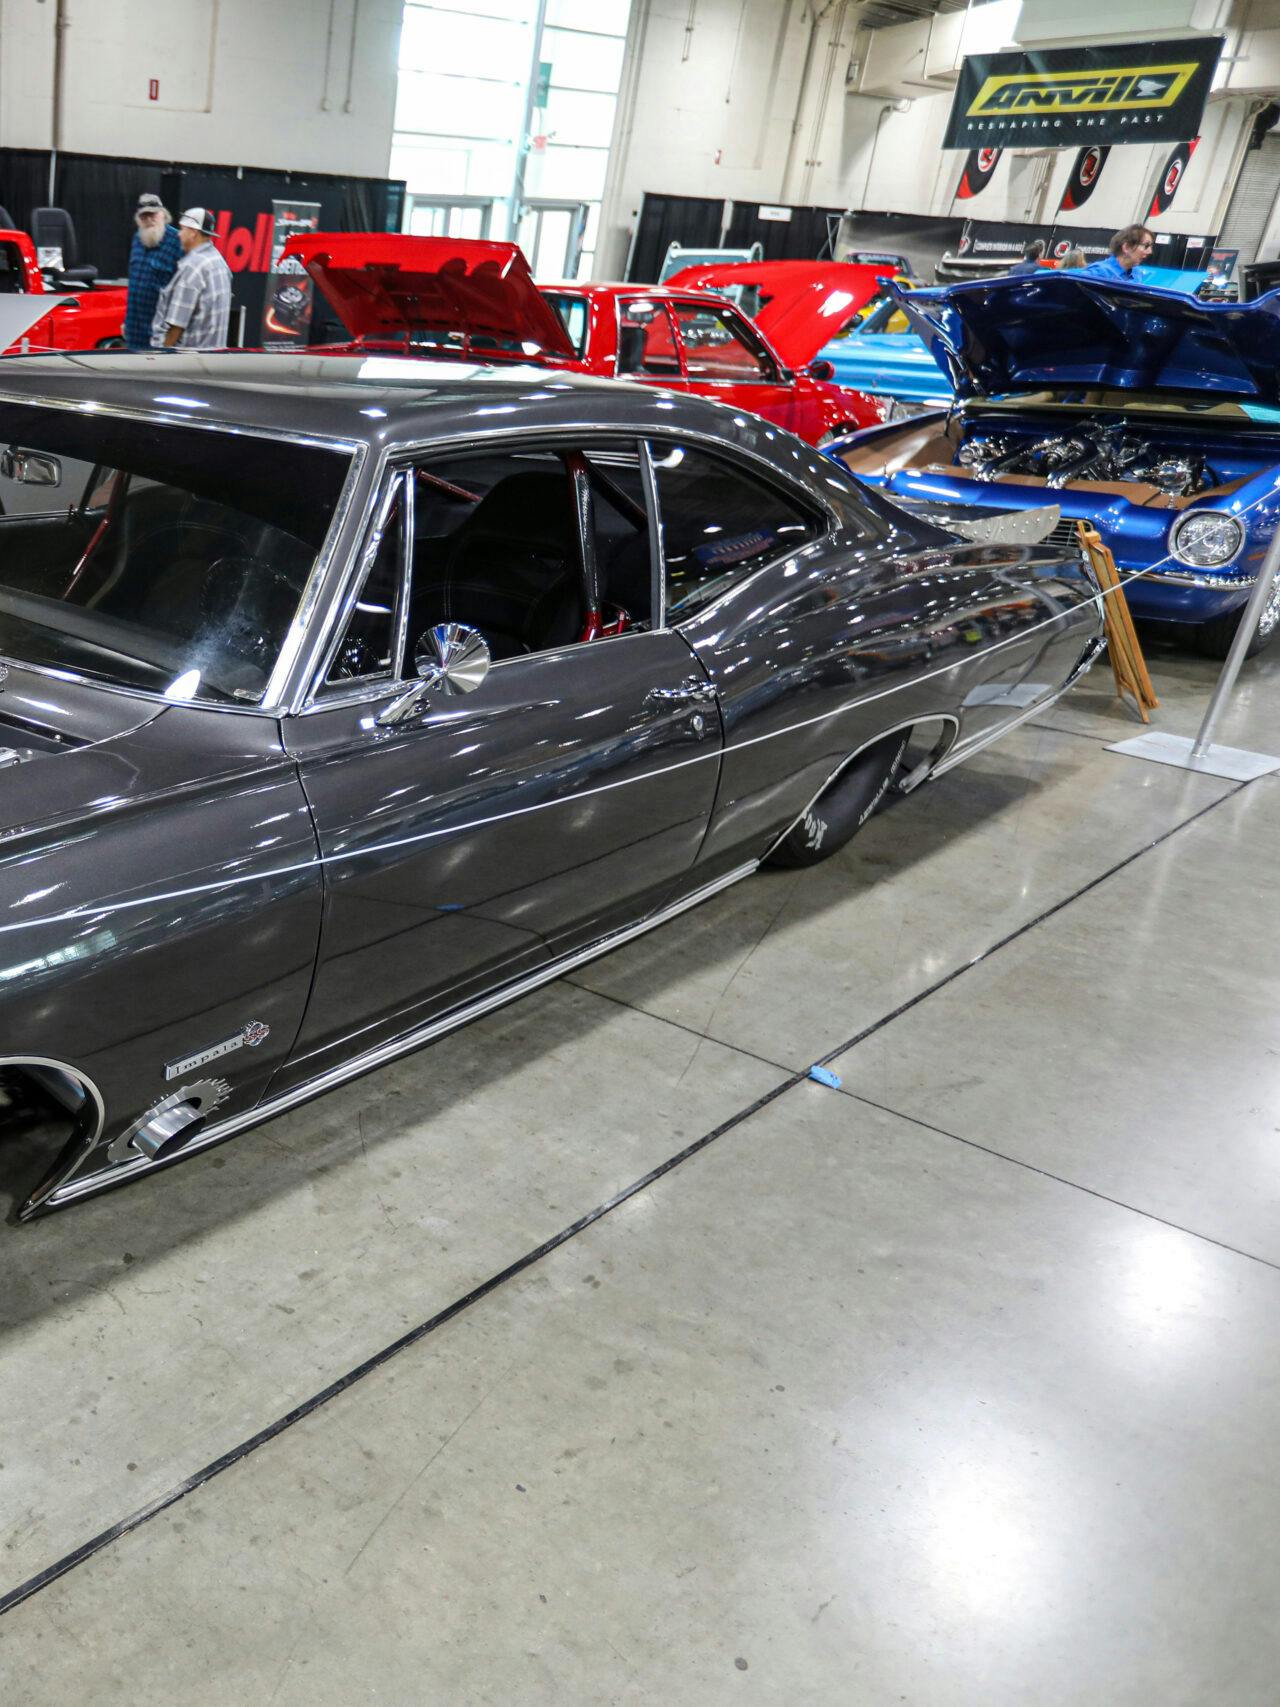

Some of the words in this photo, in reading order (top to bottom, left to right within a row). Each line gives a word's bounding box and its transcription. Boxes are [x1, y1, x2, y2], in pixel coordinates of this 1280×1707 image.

[967, 119, 1062, 131] RESHAPING
[1076, 117, 1107, 127] THE
[1120, 114, 1164, 125] PAST
[175, 1041, 239, 1074] Impala
